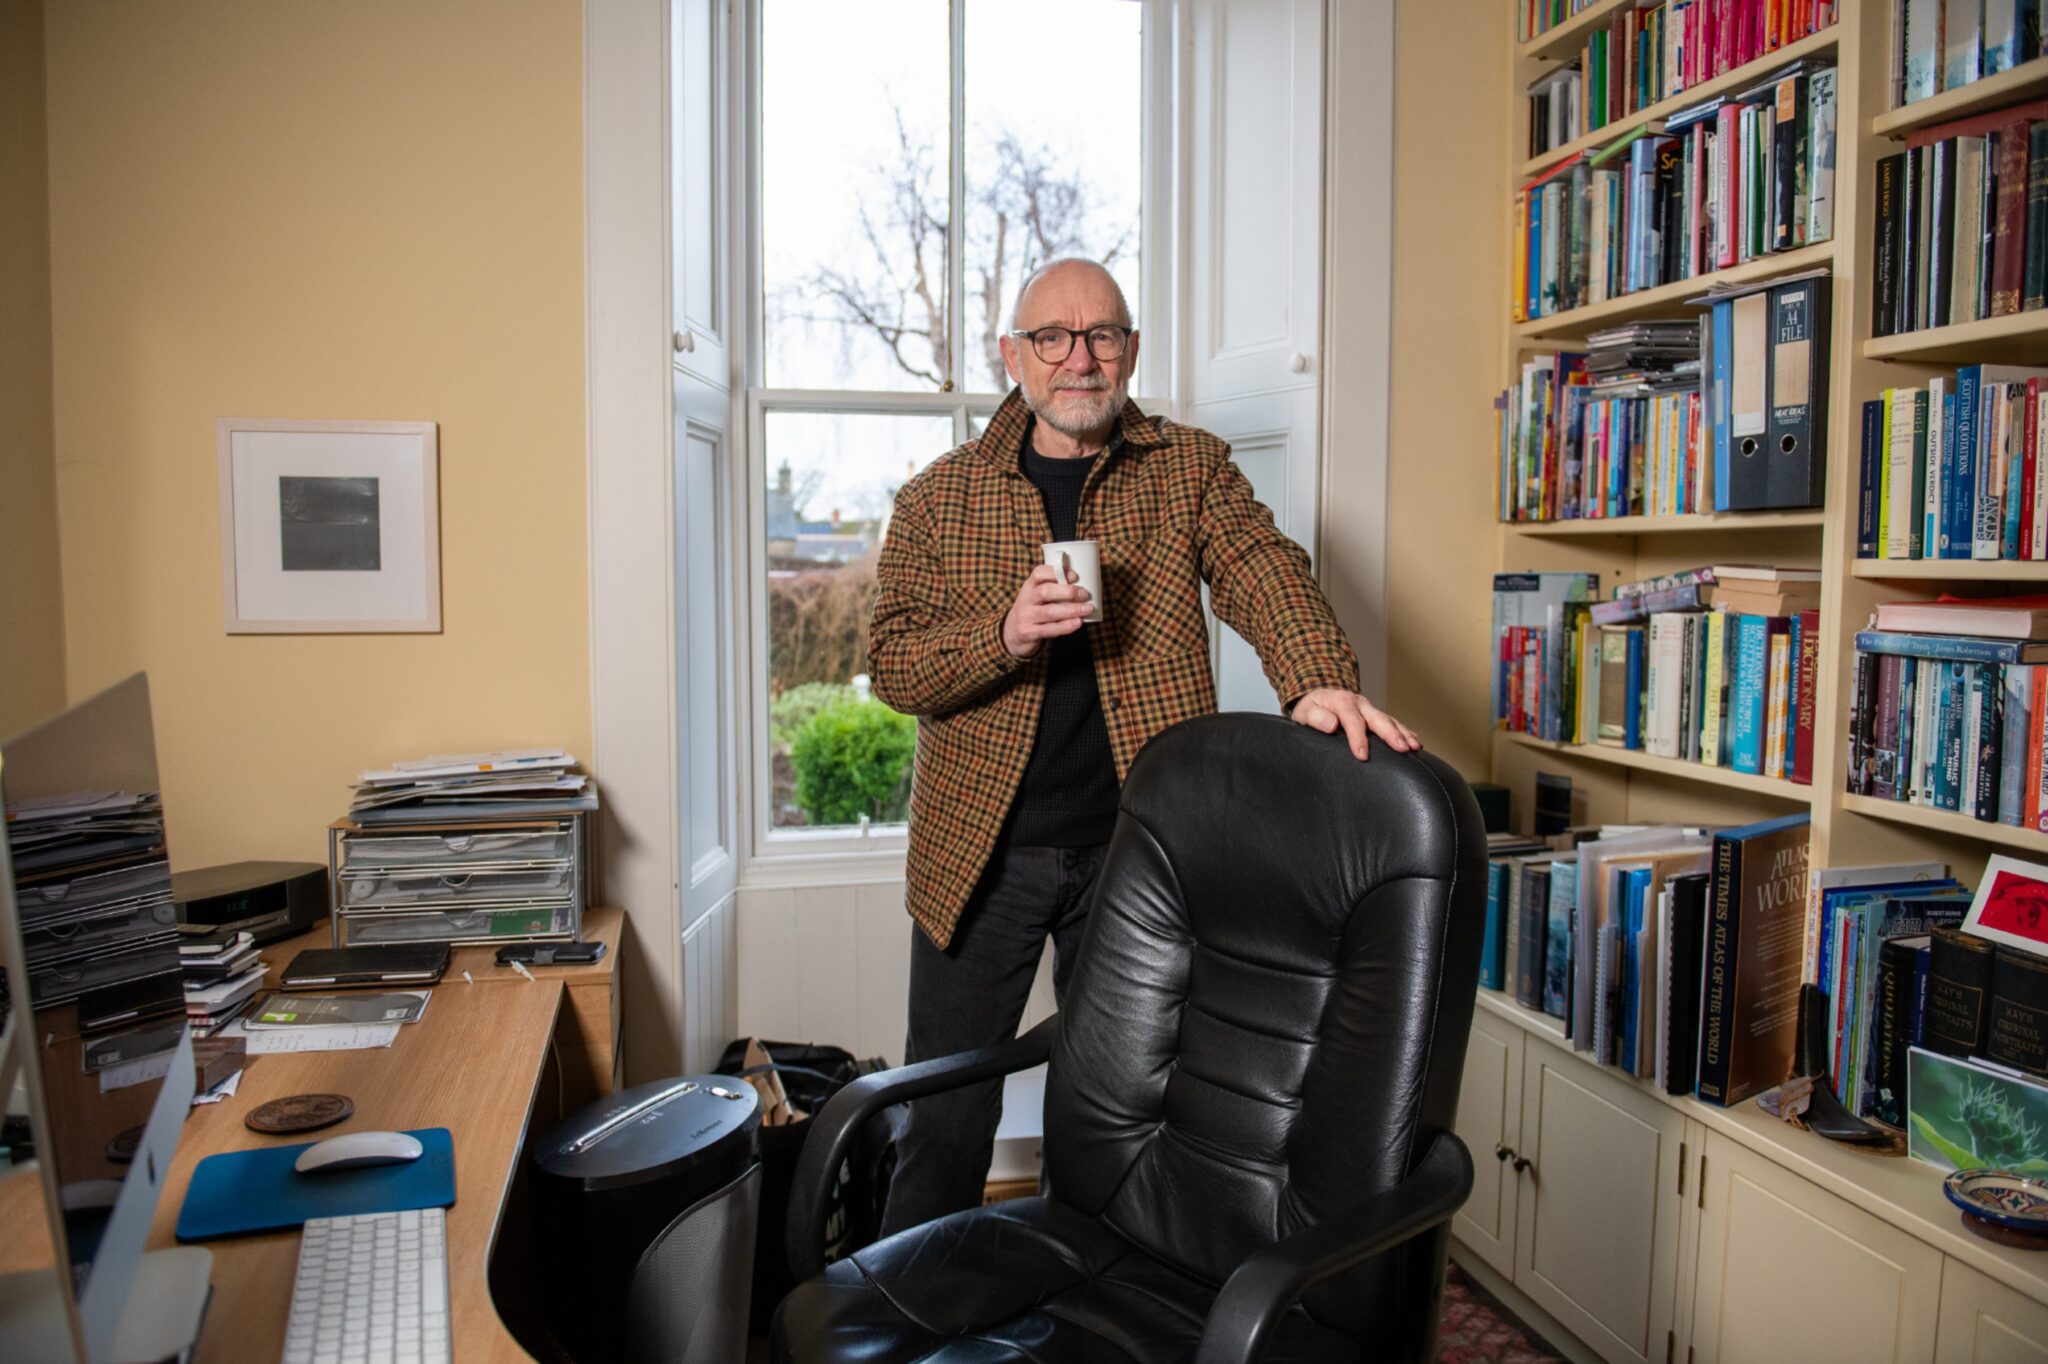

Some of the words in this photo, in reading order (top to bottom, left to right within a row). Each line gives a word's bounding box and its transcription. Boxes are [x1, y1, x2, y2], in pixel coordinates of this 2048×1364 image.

[1883, 162, 1891, 190] JAMES
[1882, 191, 1890, 217] HOGG
[1884, 221, 1892, 231] The
[1883, 256, 1891, 272] Relics
[1882, 281, 1891, 304] Scotland
[1781, 325, 1803, 342] FILE
[1786, 310, 1797, 326] A4
[1775, 408, 1787, 418] NEAT
[1788, 406, 1806, 416] IDEAS
[1960, 379, 1973, 420] SCOTTISH
[2026, 399, 2037, 434] Conceiving
[1929, 430, 1938, 466] OUTSIDE
[1957, 421, 1971, 476] QUOTATIONS
[2025, 439, 2035, 460] Nation
[2037, 460, 2046, 474] and
[1928, 469, 1937, 505] VERDICT
[1975, 496, 1986, 541] CALDER
[1984, 496, 1999, 541] ANGUS
[1711, 624, 1722, 657] NEWS
[1740, 624, 1749, 668] HISTORY
[1746, 624, 1756, 683] SCOTTISH
[1754, 624, 1765, 690] DICTIONARY
[1861, 637, 1873, 645] The
[1912, 641, 1930, 653] Truth
[1935, 643, 1955, 656] James
[1955, 644, 1992, 657] Robertson
[1711, 662, 1720, 677] OF
[1790, 658, 1799, 705] QUOTATIONS
[1800, 638, 1815, 731] DICTIONARY
[1709, 681, 1720, 704] THE
[1949, 681, 1957, 731] ROBERTSON
[1983, 671, 1992, 708] GIDEON
[1736, 677, 1746, 740] THEOLOGY
[1743, 685, 1753, 733] CHURCH
[1708, 709, 1718, 743] DEAD
[1981, 710, 1990, 742] MACK
[1951, 738, 1961, 787] REPUBLICS
[1719, 843, 1732, 872] THE
[1771, 844, 1809, 880] ATLAS
[1716, 873, 1731, 921] TIMES
[1757, 873, 1806, 912] WORL
[1713, 923, 1727, 964] ATLAS
[1712, 965, 1724, 987] OF
[1710, 987, 1723, 1013] THE
[1934, 997, 1969, 1016] RIGINAL
[2004, 1006, 2034, 1024] KAY'S
[1882, 971, 1896, 1081] QUOTATIONS
[1933, 1009, 1973, 1030] RTRAITS
[1996, 1018, 2041, 1041] ORIGINAL
[1707, 1015, 1721, 1065] WORLD
[1992, 1030, 2044, 1056] PORTRAITS
